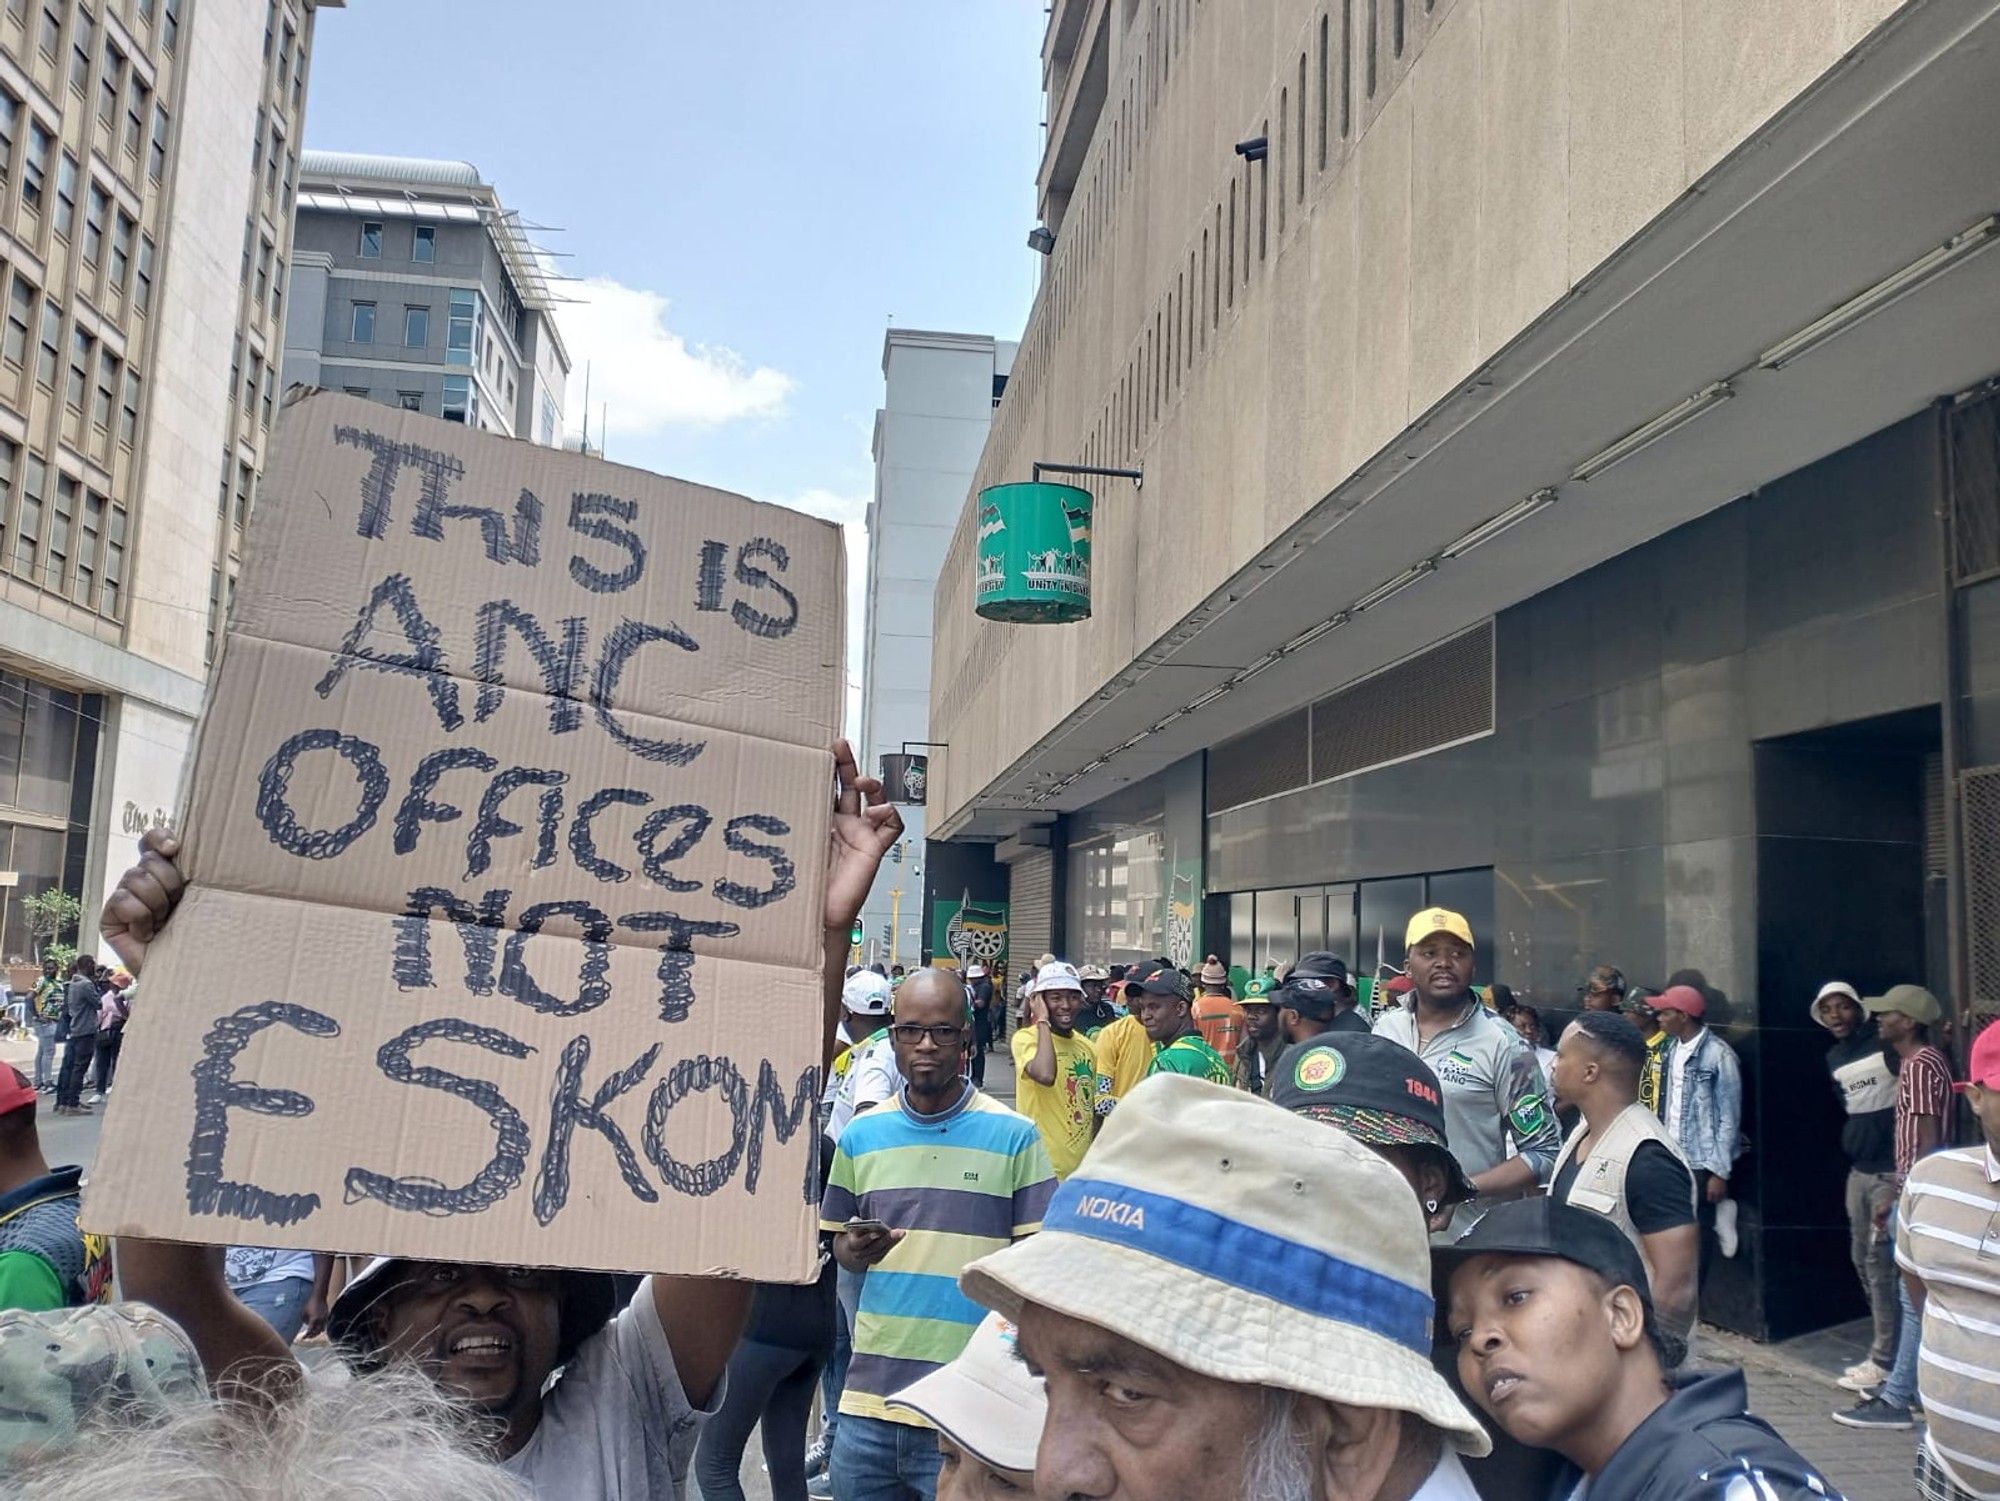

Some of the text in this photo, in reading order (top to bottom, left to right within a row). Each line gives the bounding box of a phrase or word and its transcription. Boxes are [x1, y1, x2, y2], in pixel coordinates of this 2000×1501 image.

[334, 424, 799, 638] THIS IS
[316, 572, 707, 767] ANC
[393, 886, 740, 1023] NOT
[185, 1001, 821, 1227] ESKOM
[1076, 1195, 1145, 1231] NOKIA
